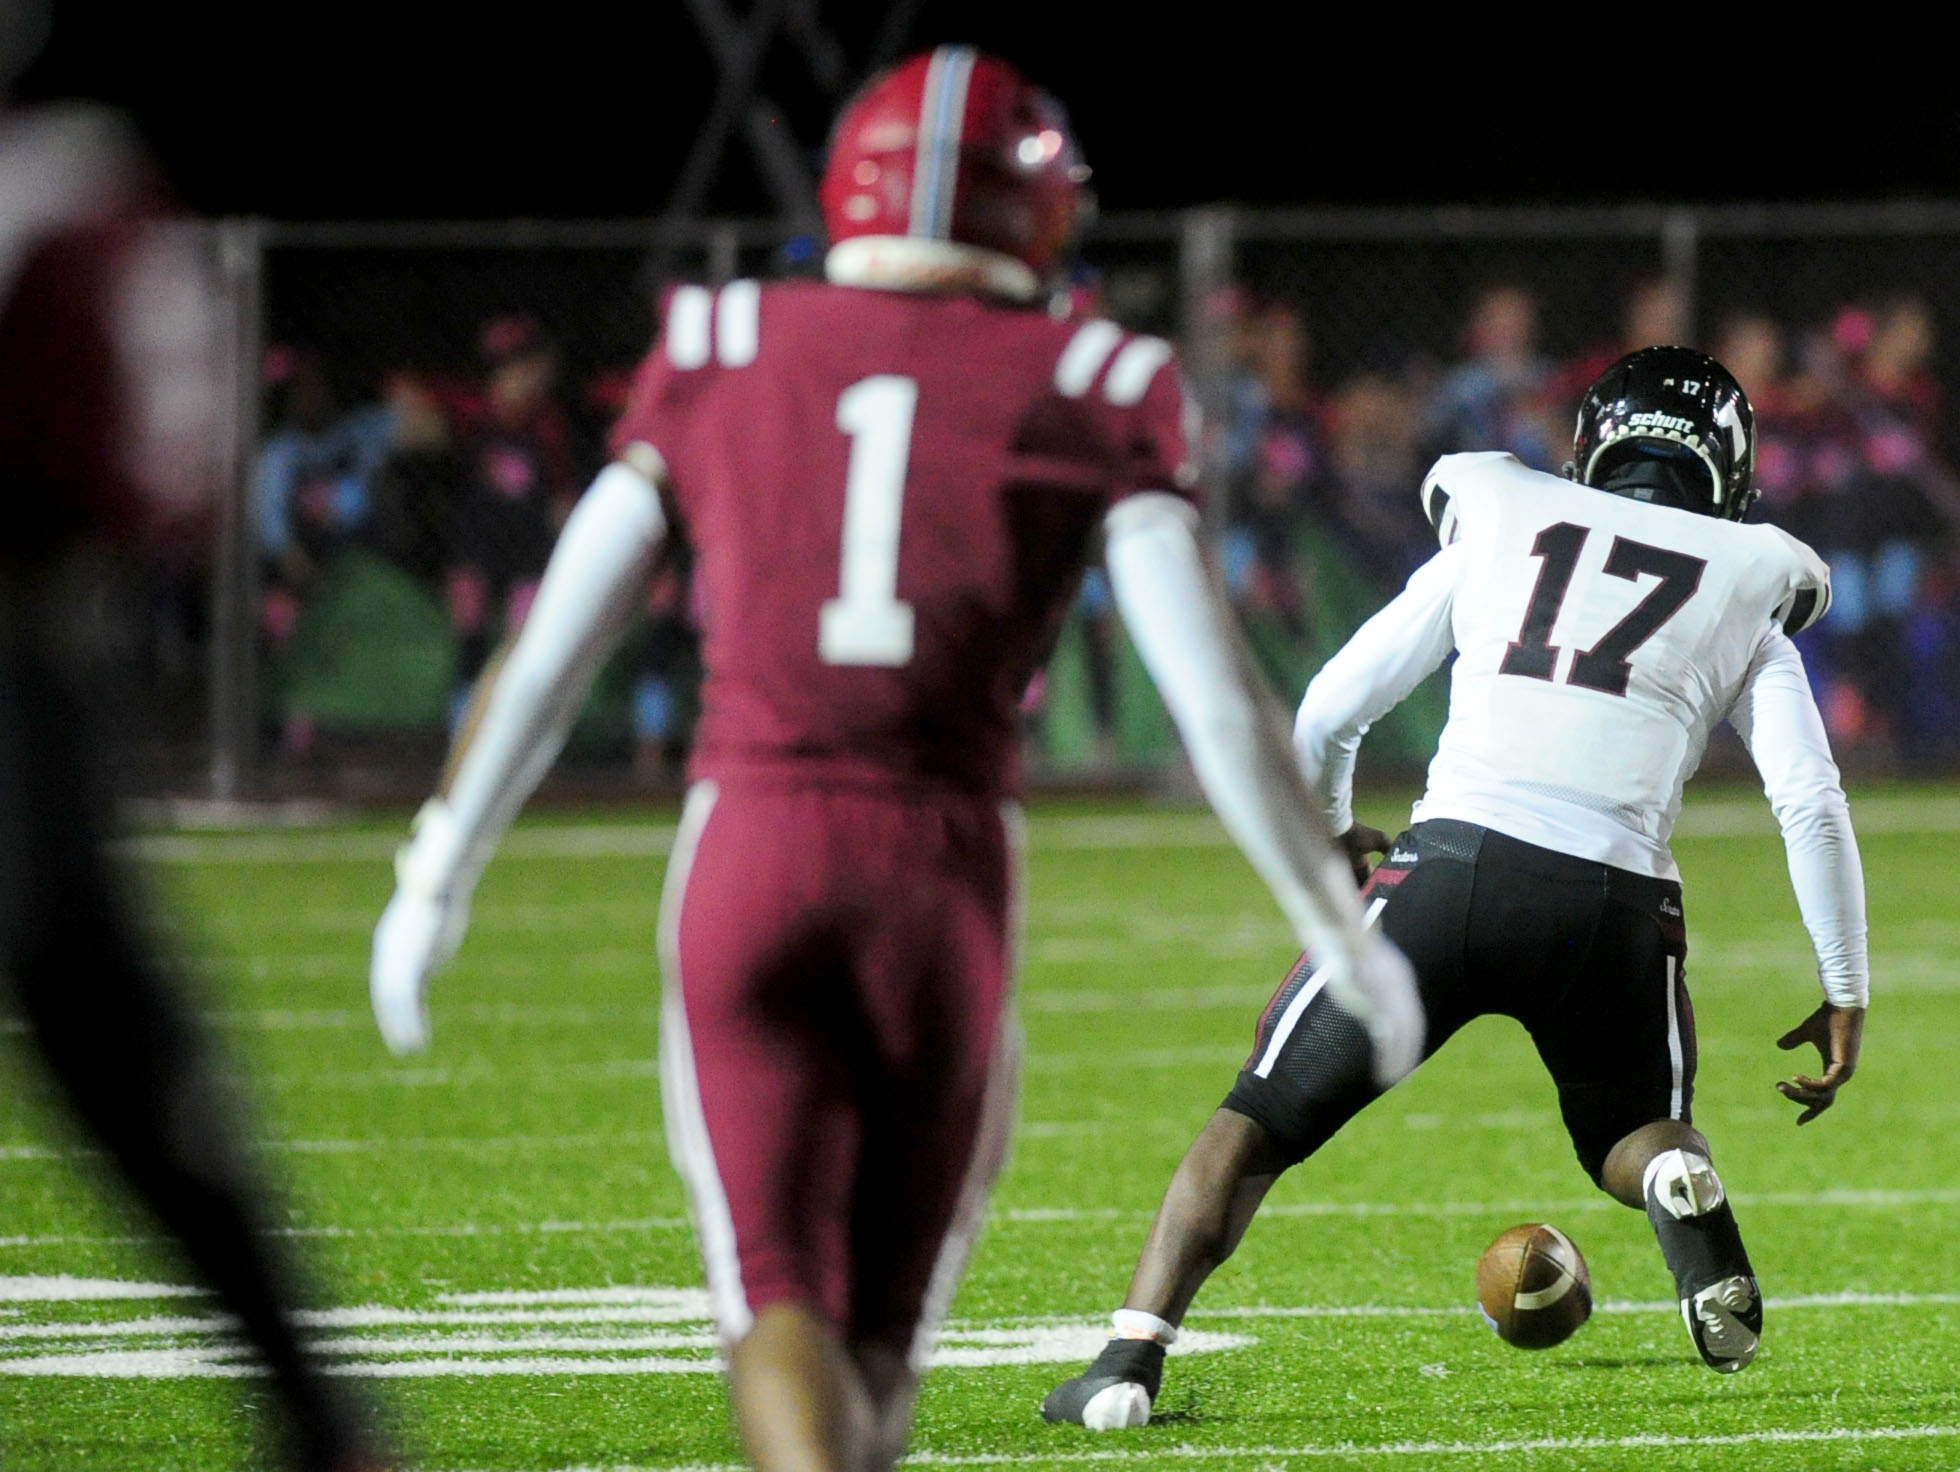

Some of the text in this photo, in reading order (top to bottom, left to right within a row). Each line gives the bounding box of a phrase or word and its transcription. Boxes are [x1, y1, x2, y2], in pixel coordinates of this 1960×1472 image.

[1628, 410, 1695, 434] schutt
[1682, 379, 1701, 396] 17
[818, 374, 919, 668] 1
[1498, 521, 1708, 698] 17
